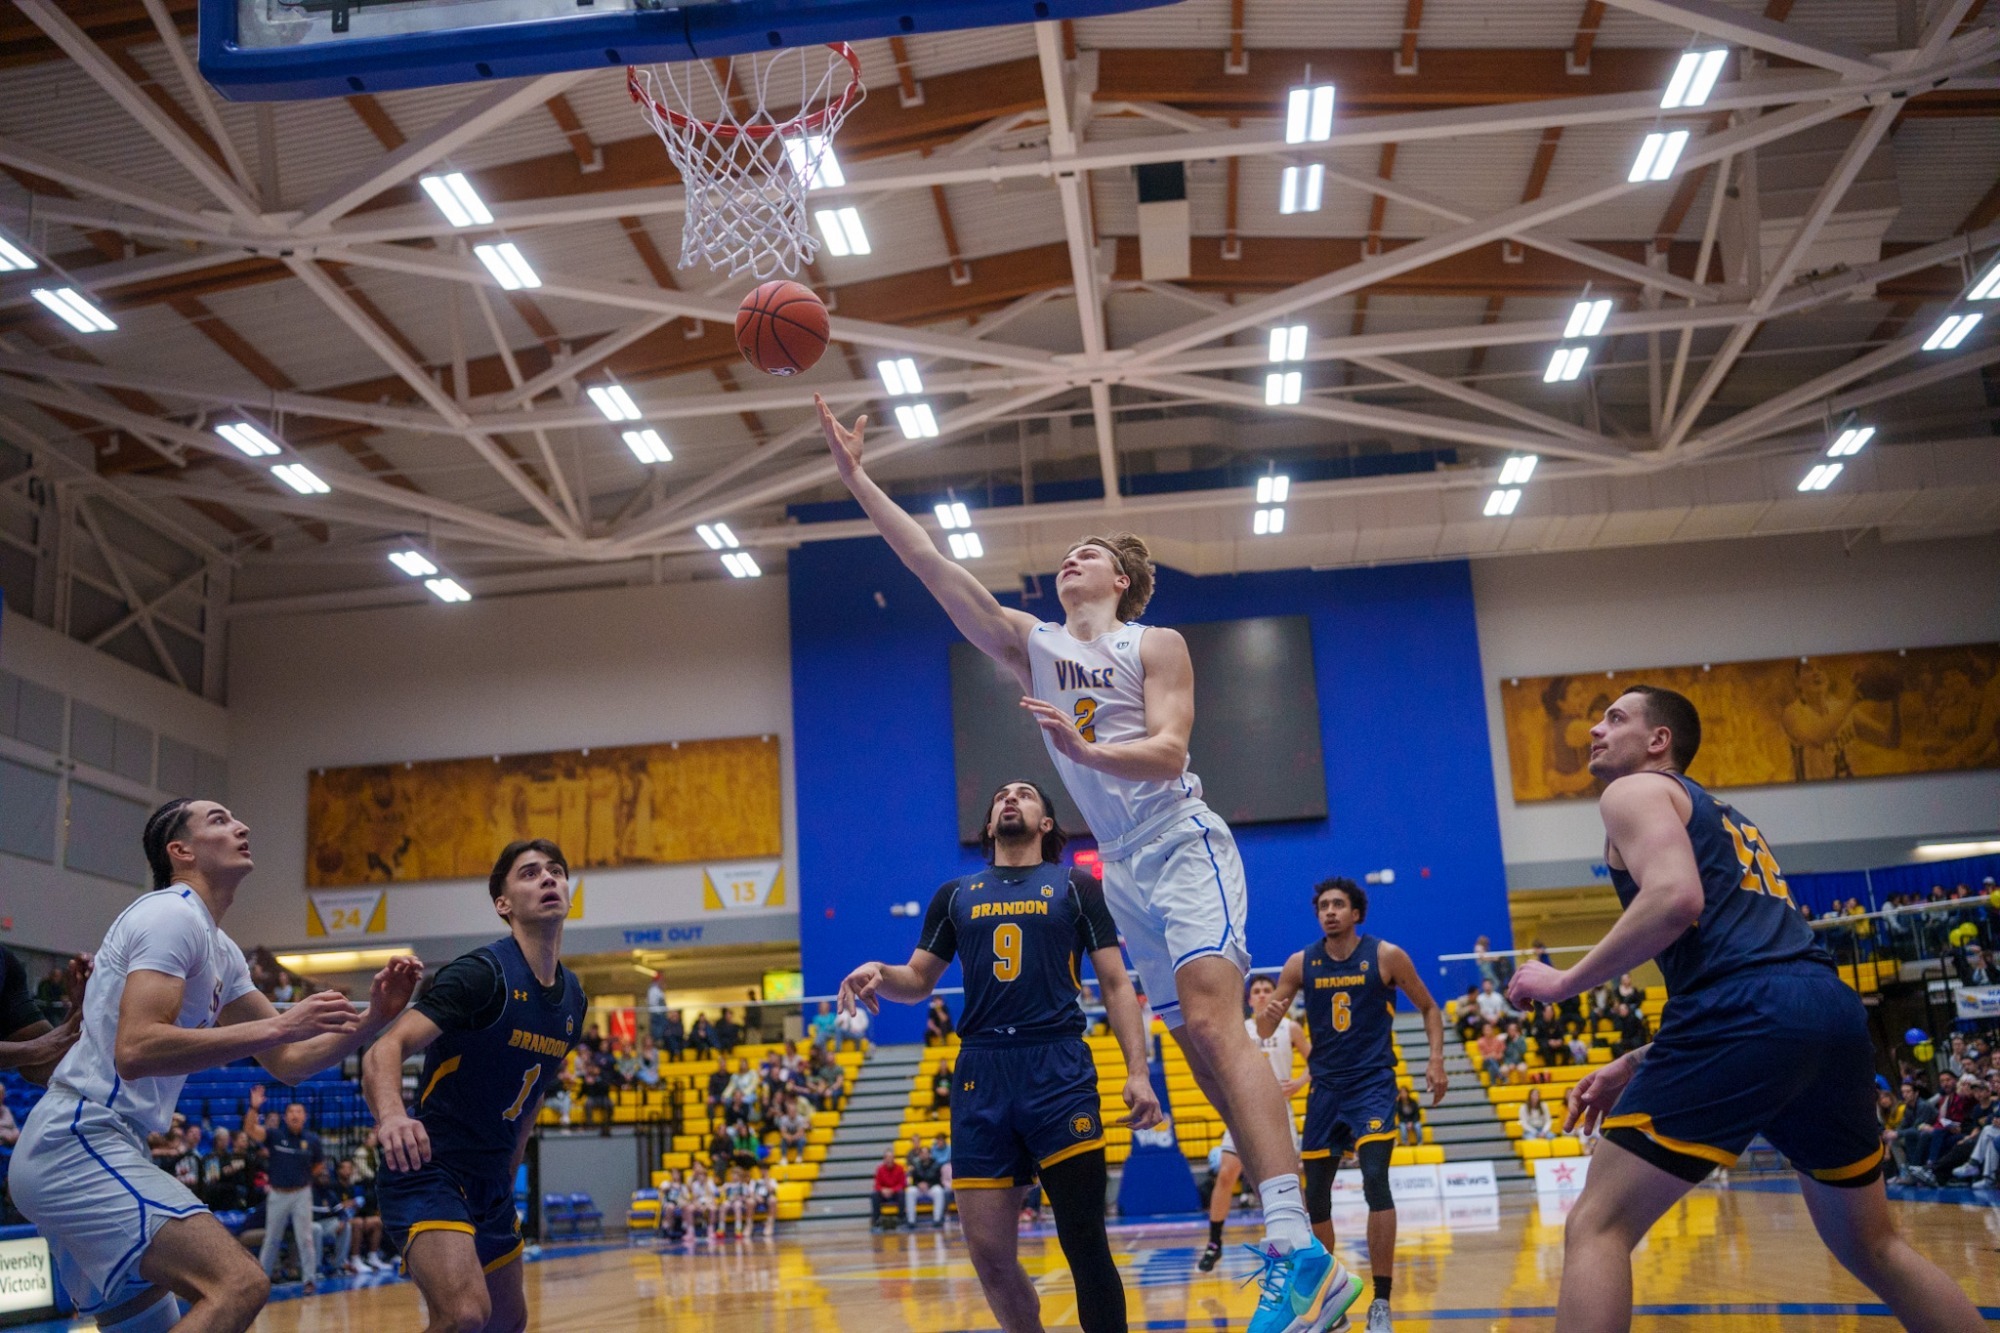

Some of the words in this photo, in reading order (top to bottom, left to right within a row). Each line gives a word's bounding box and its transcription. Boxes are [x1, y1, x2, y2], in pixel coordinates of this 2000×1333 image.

[1055, 660, 1115, 691] VIKES
[1074, 697, 1097, 743] 2
[732, 881, 756, 903] 13
[331, 907, 361, 930] 24
[971, 900, 1048, 919] BRANDON
[623, 928, 662, 944] TIME
[668, 926, 703, 941] OUT
[993, 923, 1022, 982] 9
[1314, 975, 1365, 989] BRANDON
[1331, 992, 1351, 1032] 6
[508, 1028, 569, 1059] BRANDON
[502, 1063, 541, 1121] 1
[0, 1252, 44, 1272] iversity
[0, 1274, 46, 1294] Victoria
